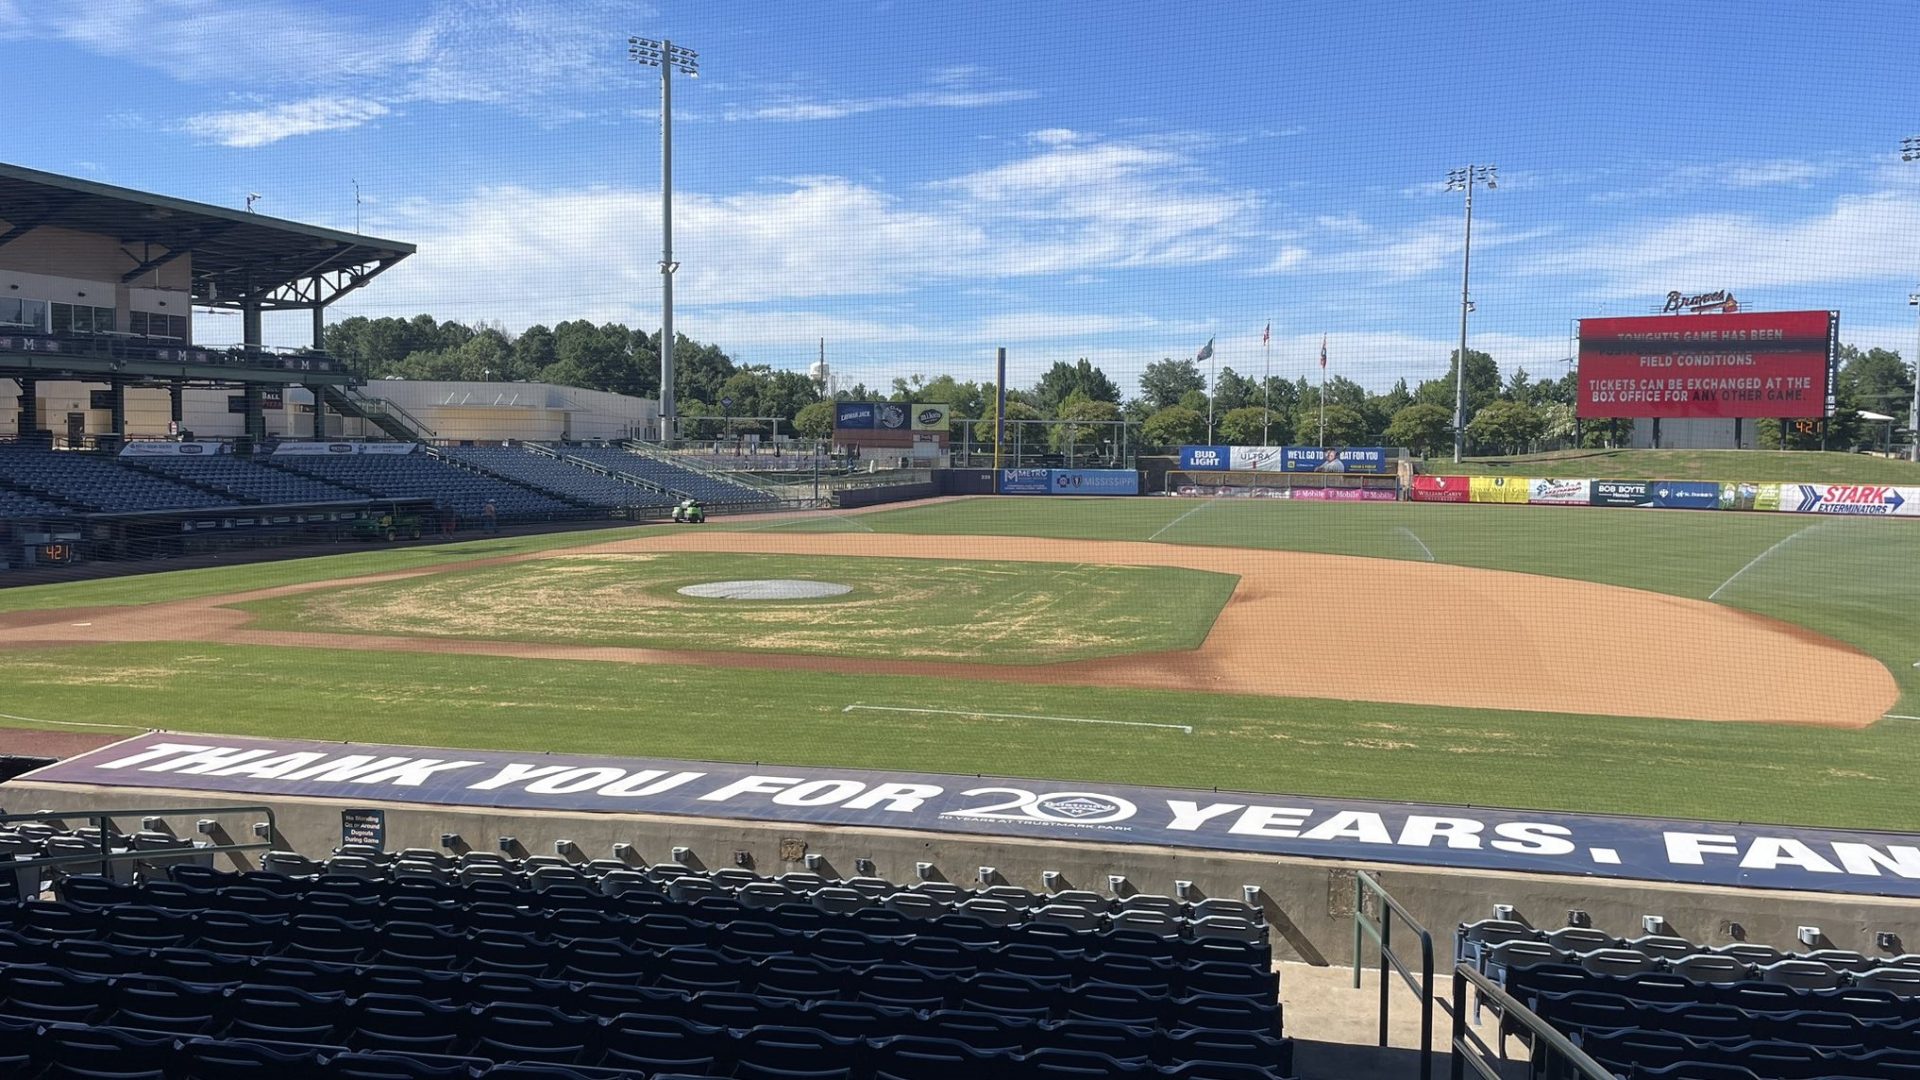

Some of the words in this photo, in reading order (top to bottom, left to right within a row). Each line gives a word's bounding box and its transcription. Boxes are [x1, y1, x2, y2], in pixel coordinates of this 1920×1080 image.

[1664, 289, 1724, 312] Braves
[1683, 331, 1717, 340] GAME
[1722, 330, 1746, 340] HAS
[1751, 329, 1783, 340] BEEN
[1640, 356, 1673, 367] FIELD
[1677, 354, 1756, 367] CONDITIONS.
[1590, 379, 1636, 390] TICKETS
[1640, 379, 1664, 390] CAN
[1668, 379, 1683, 390] BE
[1687, 378, 1761, 390] EXCHANGED
[1765, 377, 1782, 389] AT
[1787, 377, 1811, 389] THE
[1592, 391, 1615, 402] BOX
[1619, 391, 1660, 402] OFFICE
[1665, 390, 1688, 401] FOR
[1693, 390, 1717, 401] ANY
[1722, 390, 1765, 401] OTHER
[1194, 450, 1216, 458] BUD
[1240, 452, 1271, 460] ULTRA
[1287, 450, 1305, 460] WE'LL
[1306, 450, 1315, 460] GO
[1316, 451, 1324, 460] TO
[1340, 451, 1352, 460] BAT
[1353, 451, 1364, 460] FOR
[1365, 451, 1378, 460] YOU
[1190, 458, 1220, 466] LIGHT
[1598, 485, 1616, 493] BOB
[1823, 485, 1889, 503] STARK
[1818, 503, 1888, 514] EXTERMINATORS
[95, 743, 485, 787] THANK
[465, 762, 708, 798] YOU
[698, 775, 945, 814] FOR
[939, 787, 1138, 824] 20
[1166, 800, 1622, 865] YEARS.
[1017, 819, 1094, 830] TRUSTMARK
